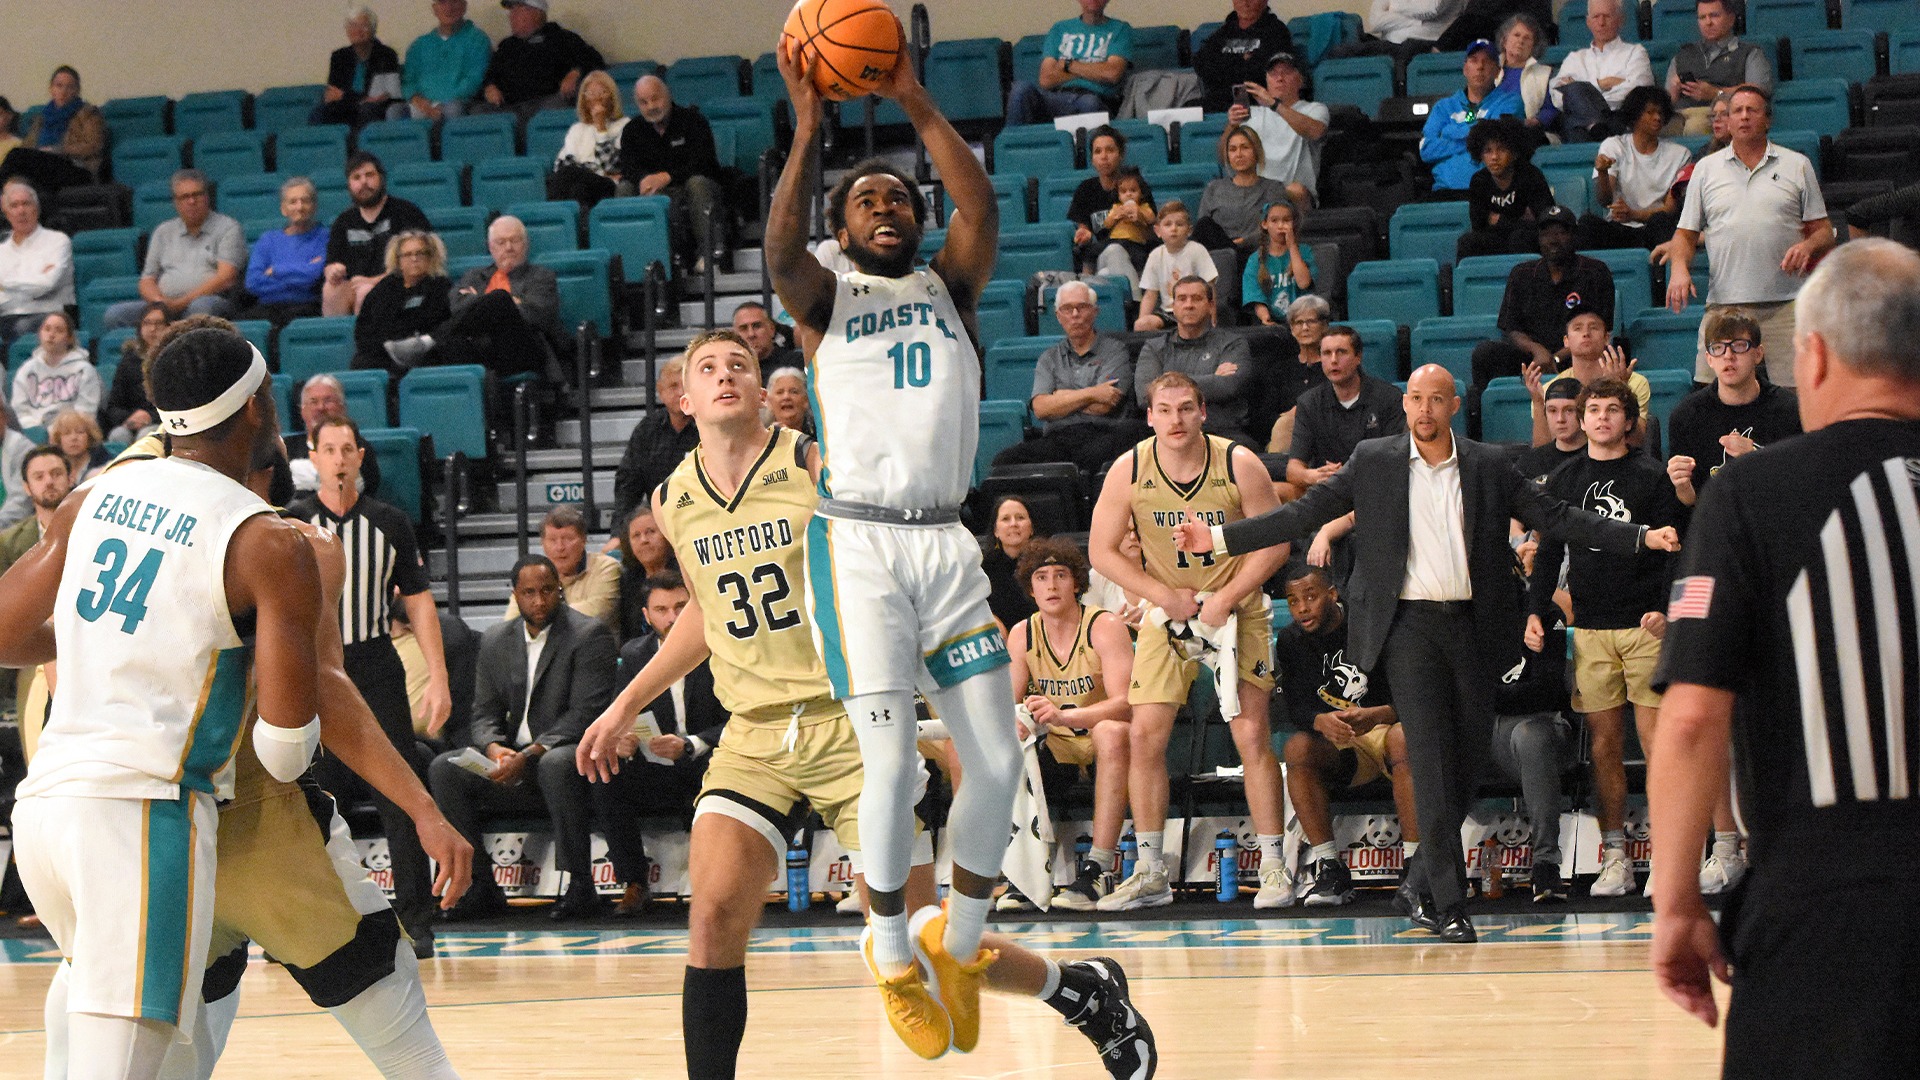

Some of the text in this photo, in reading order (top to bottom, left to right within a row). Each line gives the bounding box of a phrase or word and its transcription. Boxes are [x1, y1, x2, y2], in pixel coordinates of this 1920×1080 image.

[846, 302, 958, 343] COASTL
[887, 341, 931, 389] 10
[93, 493, 197, 547] EASLEY JR.
[693, 518, 793, 566] WOFFORD
[1153, 510, 1225, 527] WOFORD
[76, 538, 165, 634] 34
[717, 563, 802, 640] 32
